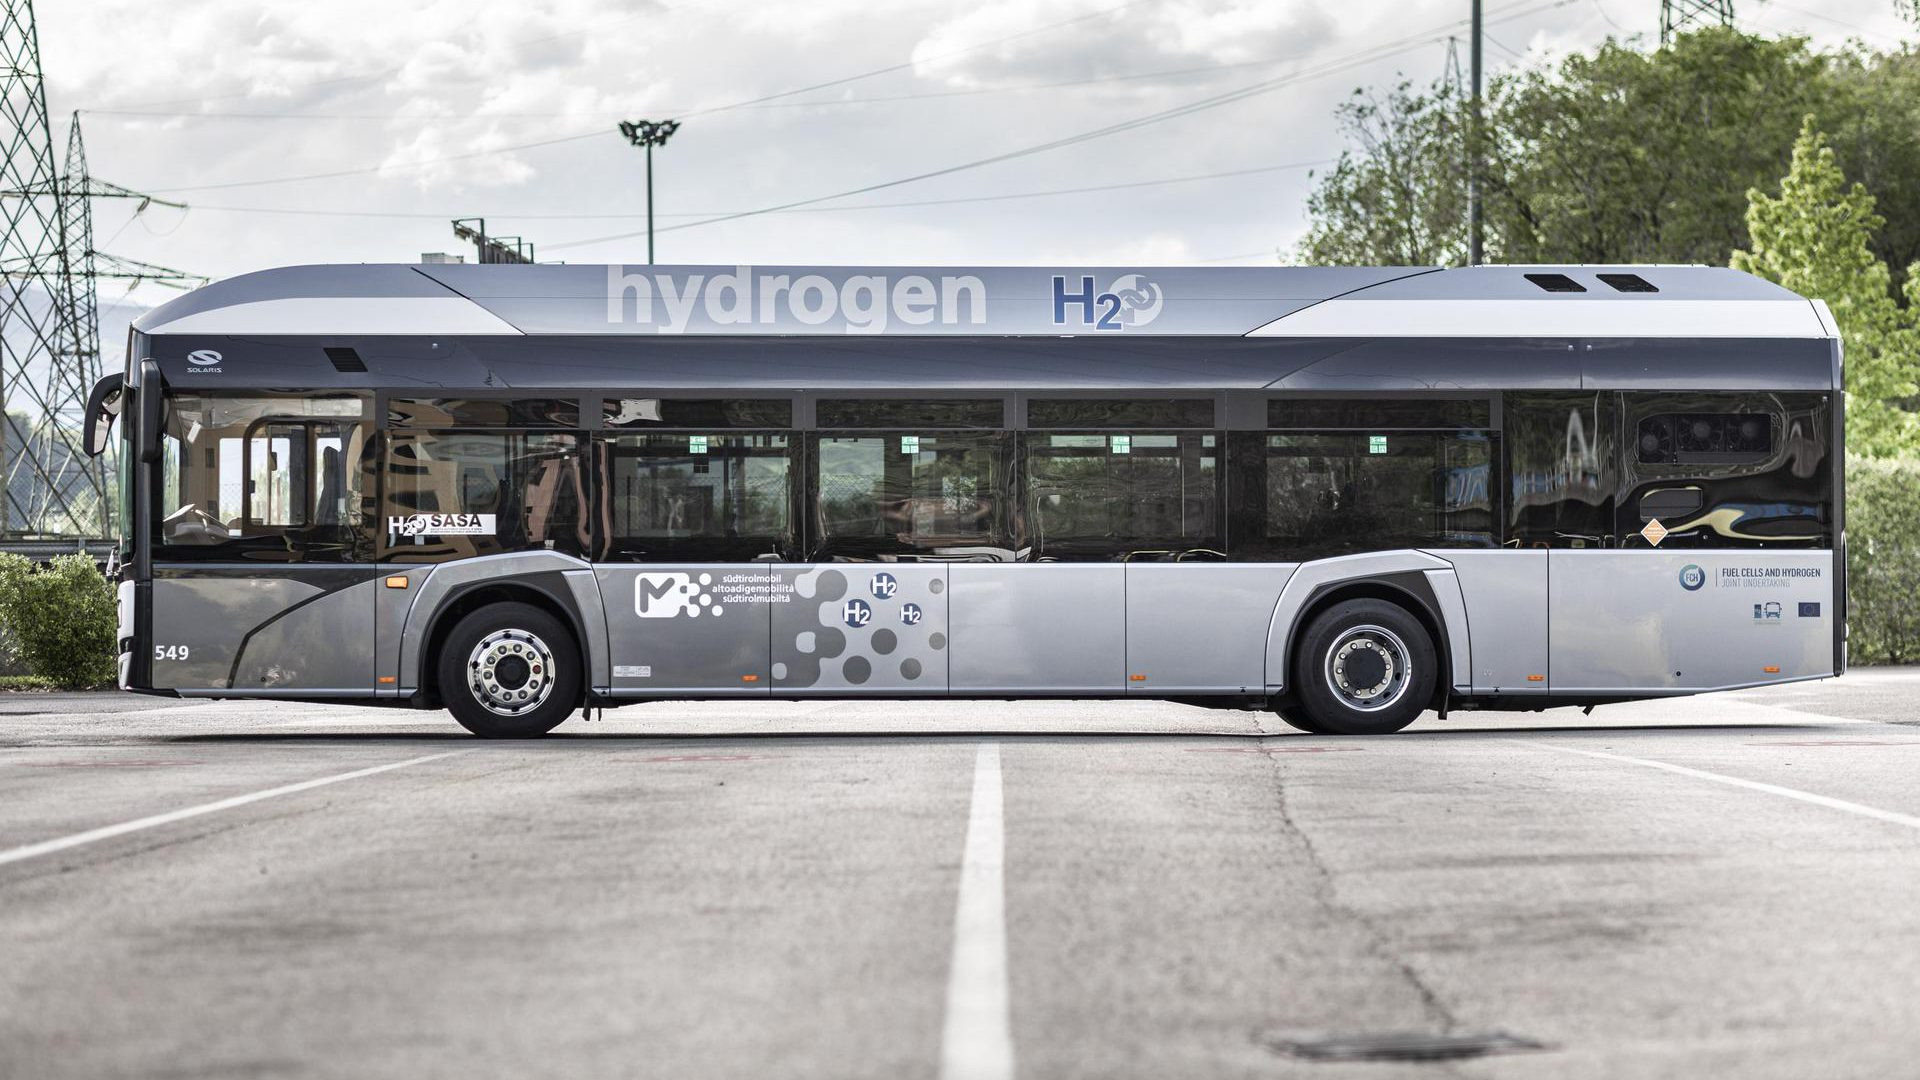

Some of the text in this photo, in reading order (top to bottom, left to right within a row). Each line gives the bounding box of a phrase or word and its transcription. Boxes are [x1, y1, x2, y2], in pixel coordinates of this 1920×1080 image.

[607, 264, 987, 335] hydrogen
[430, 513, 482, 527] SASA
[722, 573, 782, 583] südtirolmobil
[1722, 568, 1821, 577] FUEL CELLS AND HYDROGEN
[872, 575, 897, 597] H2
[844, 602, 870, 625] H2
[900, 605, 921, 623] H2
[155, 645, 189, 660] 549
